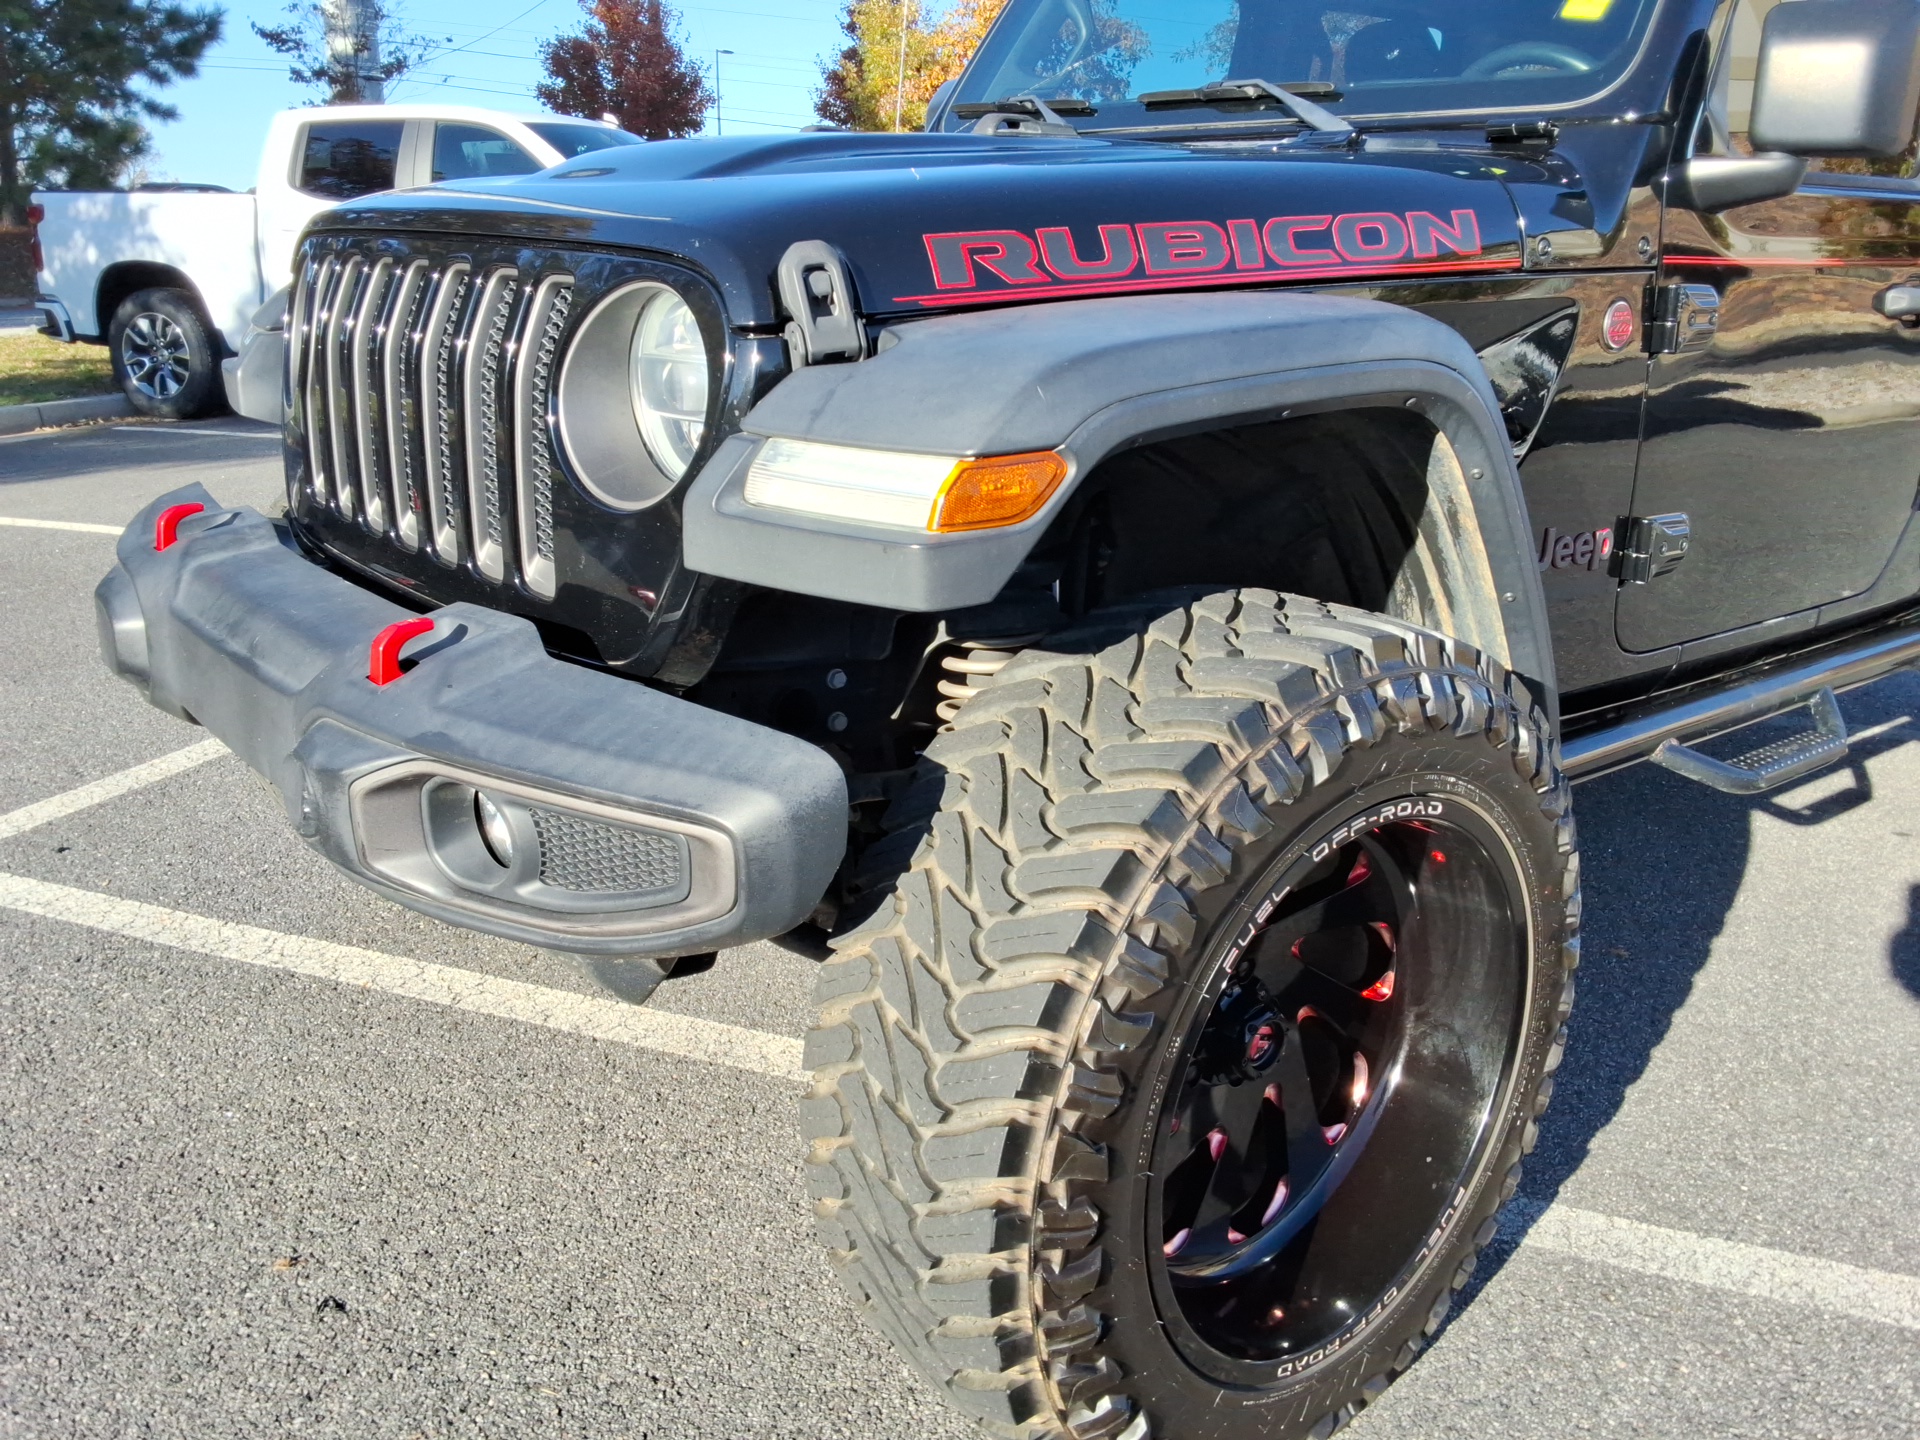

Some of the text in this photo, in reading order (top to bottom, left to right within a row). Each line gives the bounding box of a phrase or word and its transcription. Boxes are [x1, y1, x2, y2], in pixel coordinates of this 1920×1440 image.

[922, 208, 1483, 290] RUBICON
[1538, 526, 1615, 572] Jeep
[1222, 885, 1291, 974] FUEL
[1311, 800, 1444, 863] OFF-ROAD
[1414, 1185, 1466, 1263] FUEL
[1276, 1286, 1399, 1378] OFF-ROAD
